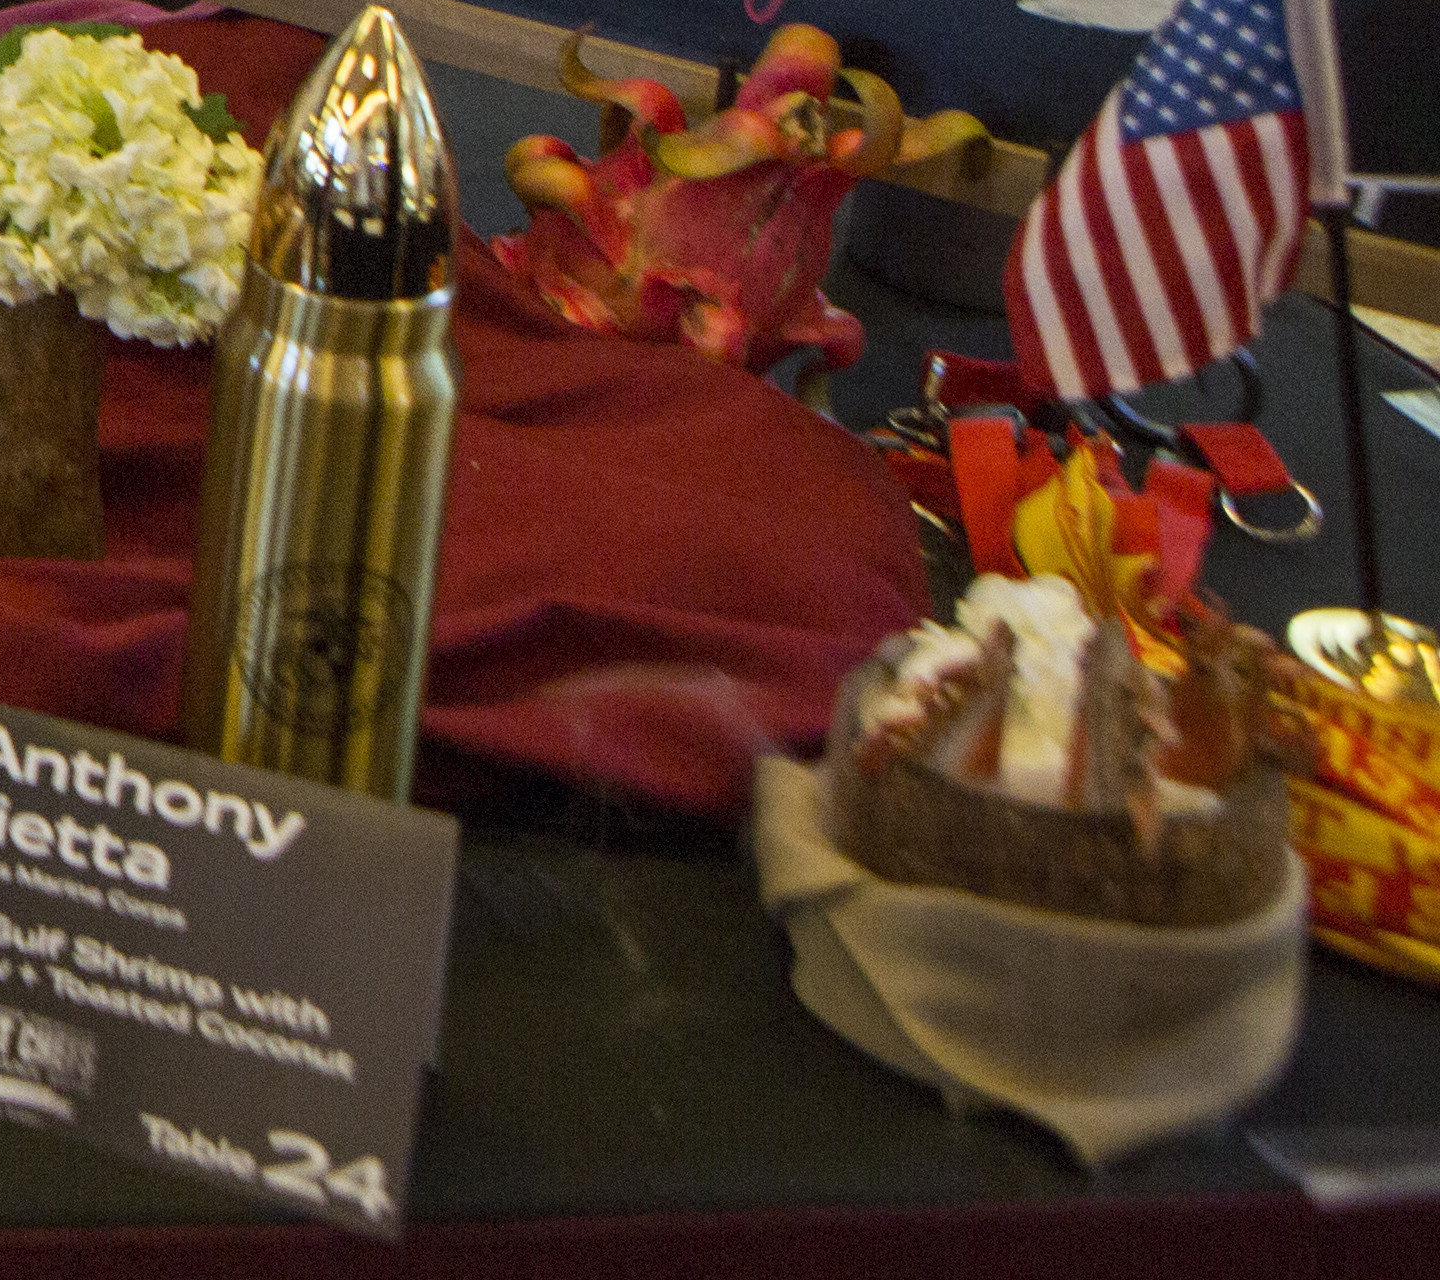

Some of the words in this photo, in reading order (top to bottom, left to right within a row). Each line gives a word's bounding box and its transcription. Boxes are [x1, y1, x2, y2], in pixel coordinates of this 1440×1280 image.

[107, 886, 188, 931] Corps
[45, 962, 193, 1035] Toasted
[196, 1009, 359, 1085] Coconut
[73, 935, 225, 1009] Shrimp
[229, 983, 332, 1040] with
[139, 1112, 258, 1184] Table
[263, 1127, 398, 1224] 24
